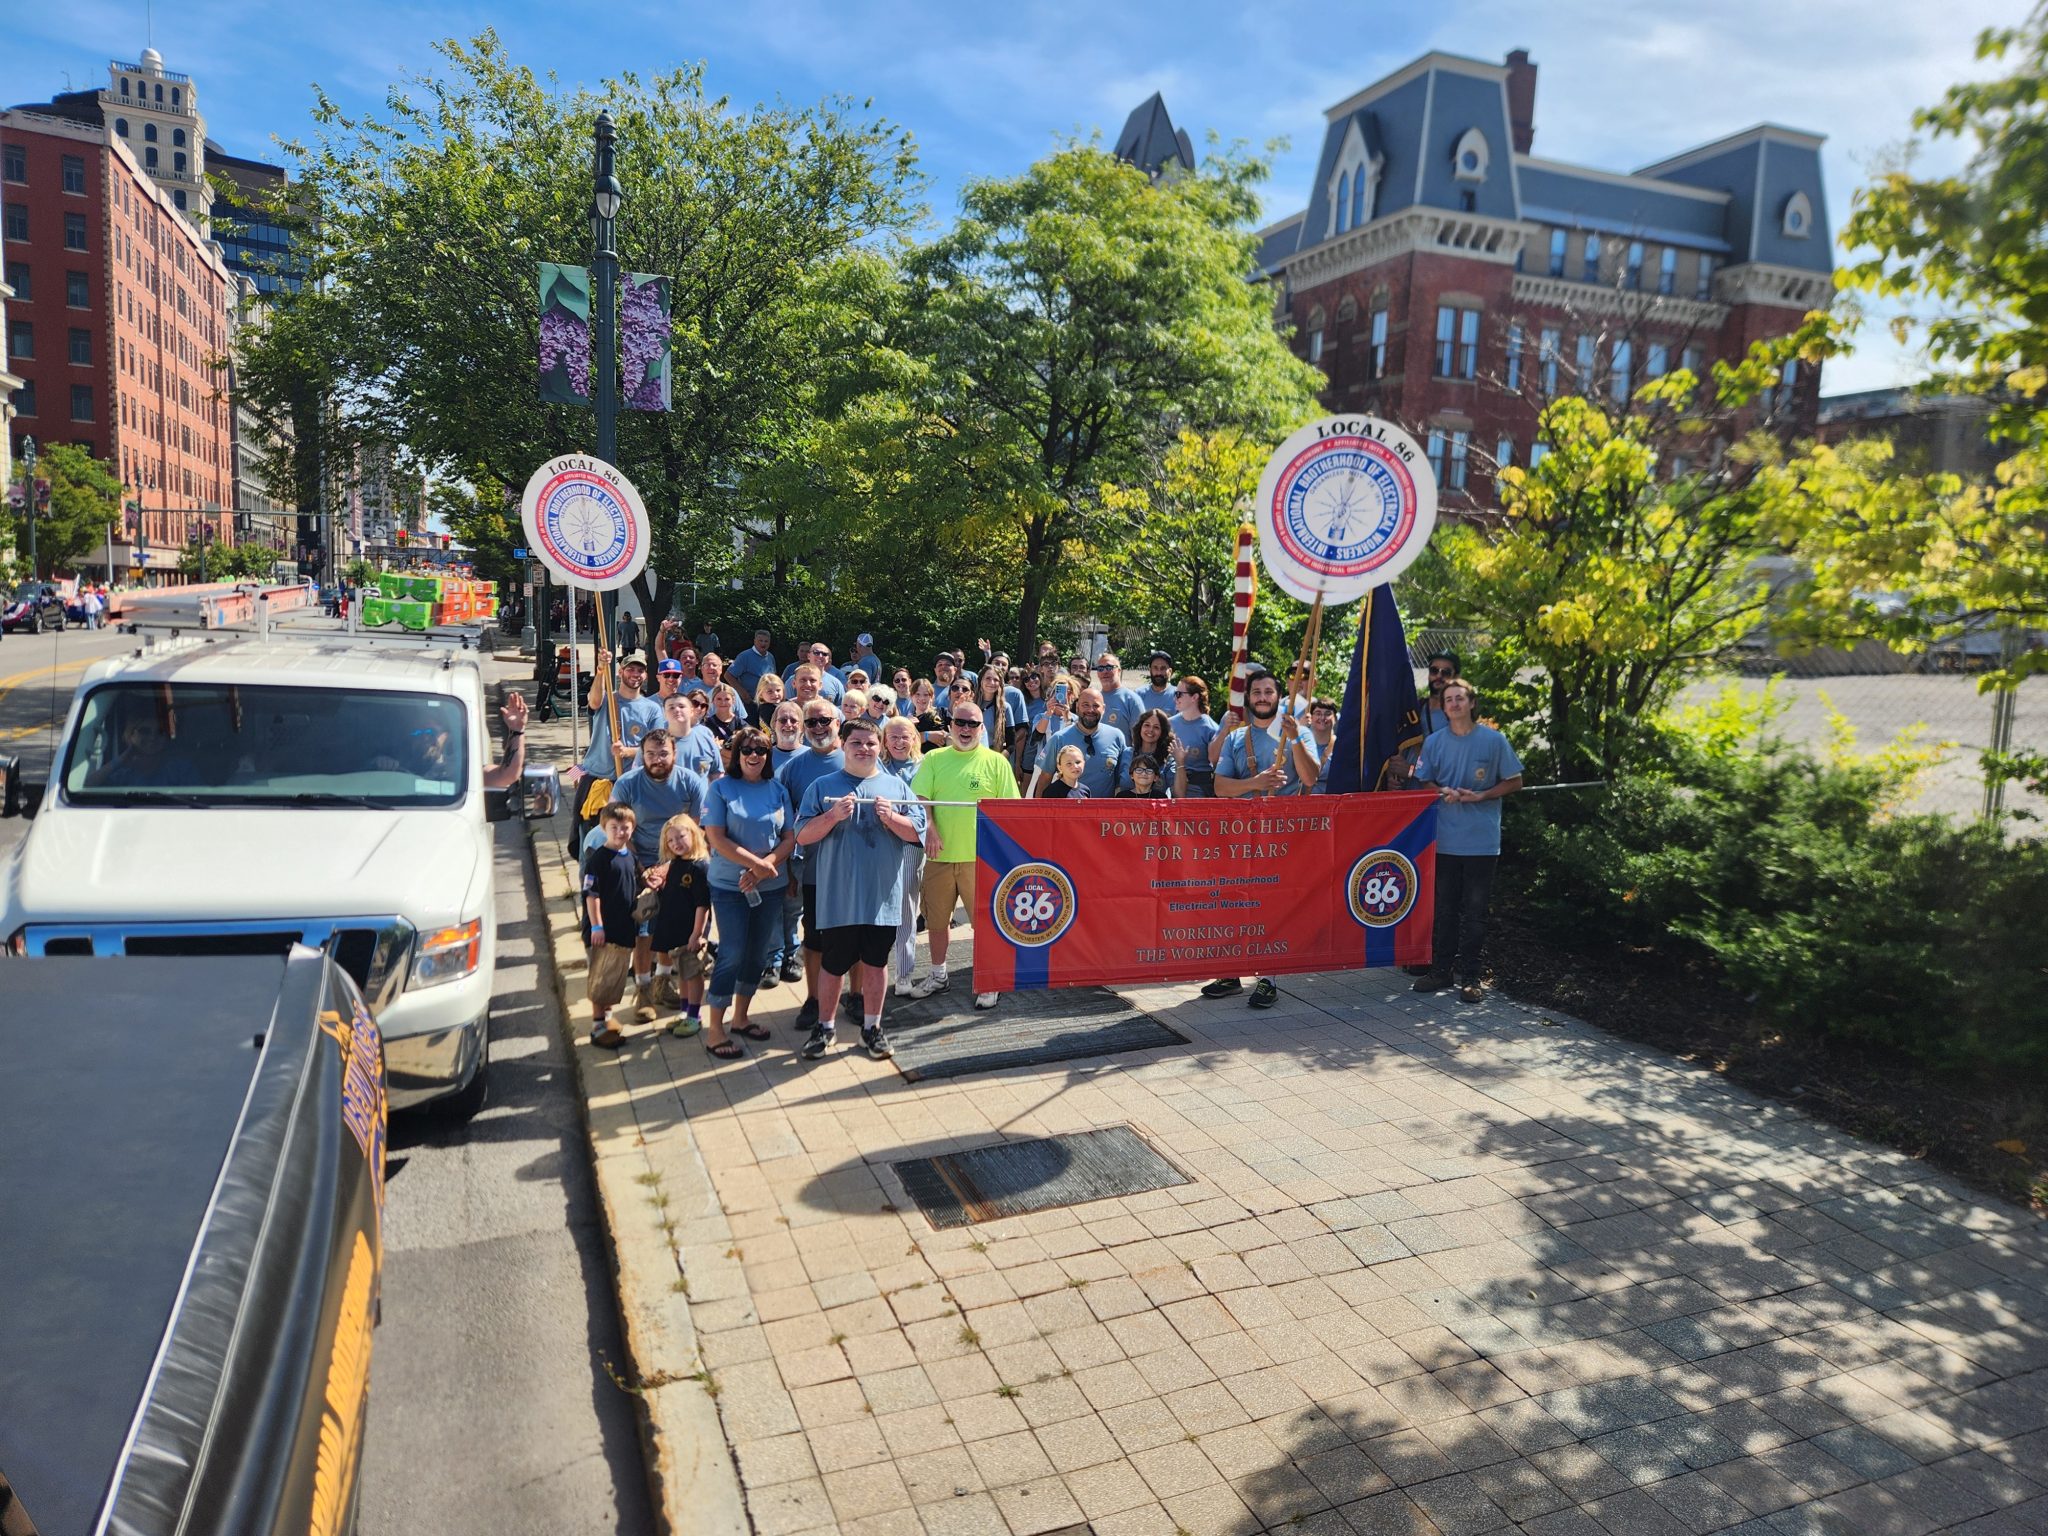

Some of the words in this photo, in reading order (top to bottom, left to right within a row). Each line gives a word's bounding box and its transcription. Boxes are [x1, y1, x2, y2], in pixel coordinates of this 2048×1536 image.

[1317, 421, 1386, 443] LOCAL
[1394, 441, 1415, 463] 86
[548, 459, 597, 475] LOCAL
[603, 470, 620, 485] 86
[1297, 455, 1368, 489] BROTHERHOOD
[1366, 460, 1383, 476] OF
[591, 488, 602, 500] OF
[1309, 469, 1344, 495] ORGANIZED
[550, 485, 590, 515] BROTHERHOOD
[1377, 471, 1399, 535] ELECTRICAL
[601, 495, 623, 541] ELECTRICAL
[1291, 488, 1329, 555] INTERNATIONAL
[549, 515, 587, 565] INTERNATIONAL
[593, 540, 622, 565] WORKERS
[1335, 531, 1386, 558] WORKERS
[1100, 820, 1211, 837] POWERING
[1219, 816, 1332, 836] ROCHESTER
[1144, 845, 1183, 861] FOR
[1192, 846, 1221, 860] 125
[1228, 842, 1289, 859] YEARS
[1006, 869, 1043, 890] BROTHERHOOD
[1151, 878, 1216, 889] International
[1219, 874, 1280, 886] Brotherhood
[1364, 876, 1400, 905] 86
[1169, 901, 1217, 912] Electrical
[1220, 900, 1261, 909] Workers
[1210, 889, 1220, 897] of
[1014, 892, 1055, 921] 86
[1162, 926, 1235, 941] WORKING
[1238, 924, 1265, 937] FOR
[1136, 949, 1166, 963] THE
[1171, 945, 1242, 961] WORKING
[1246, 941, 1289, 956] CLASS
